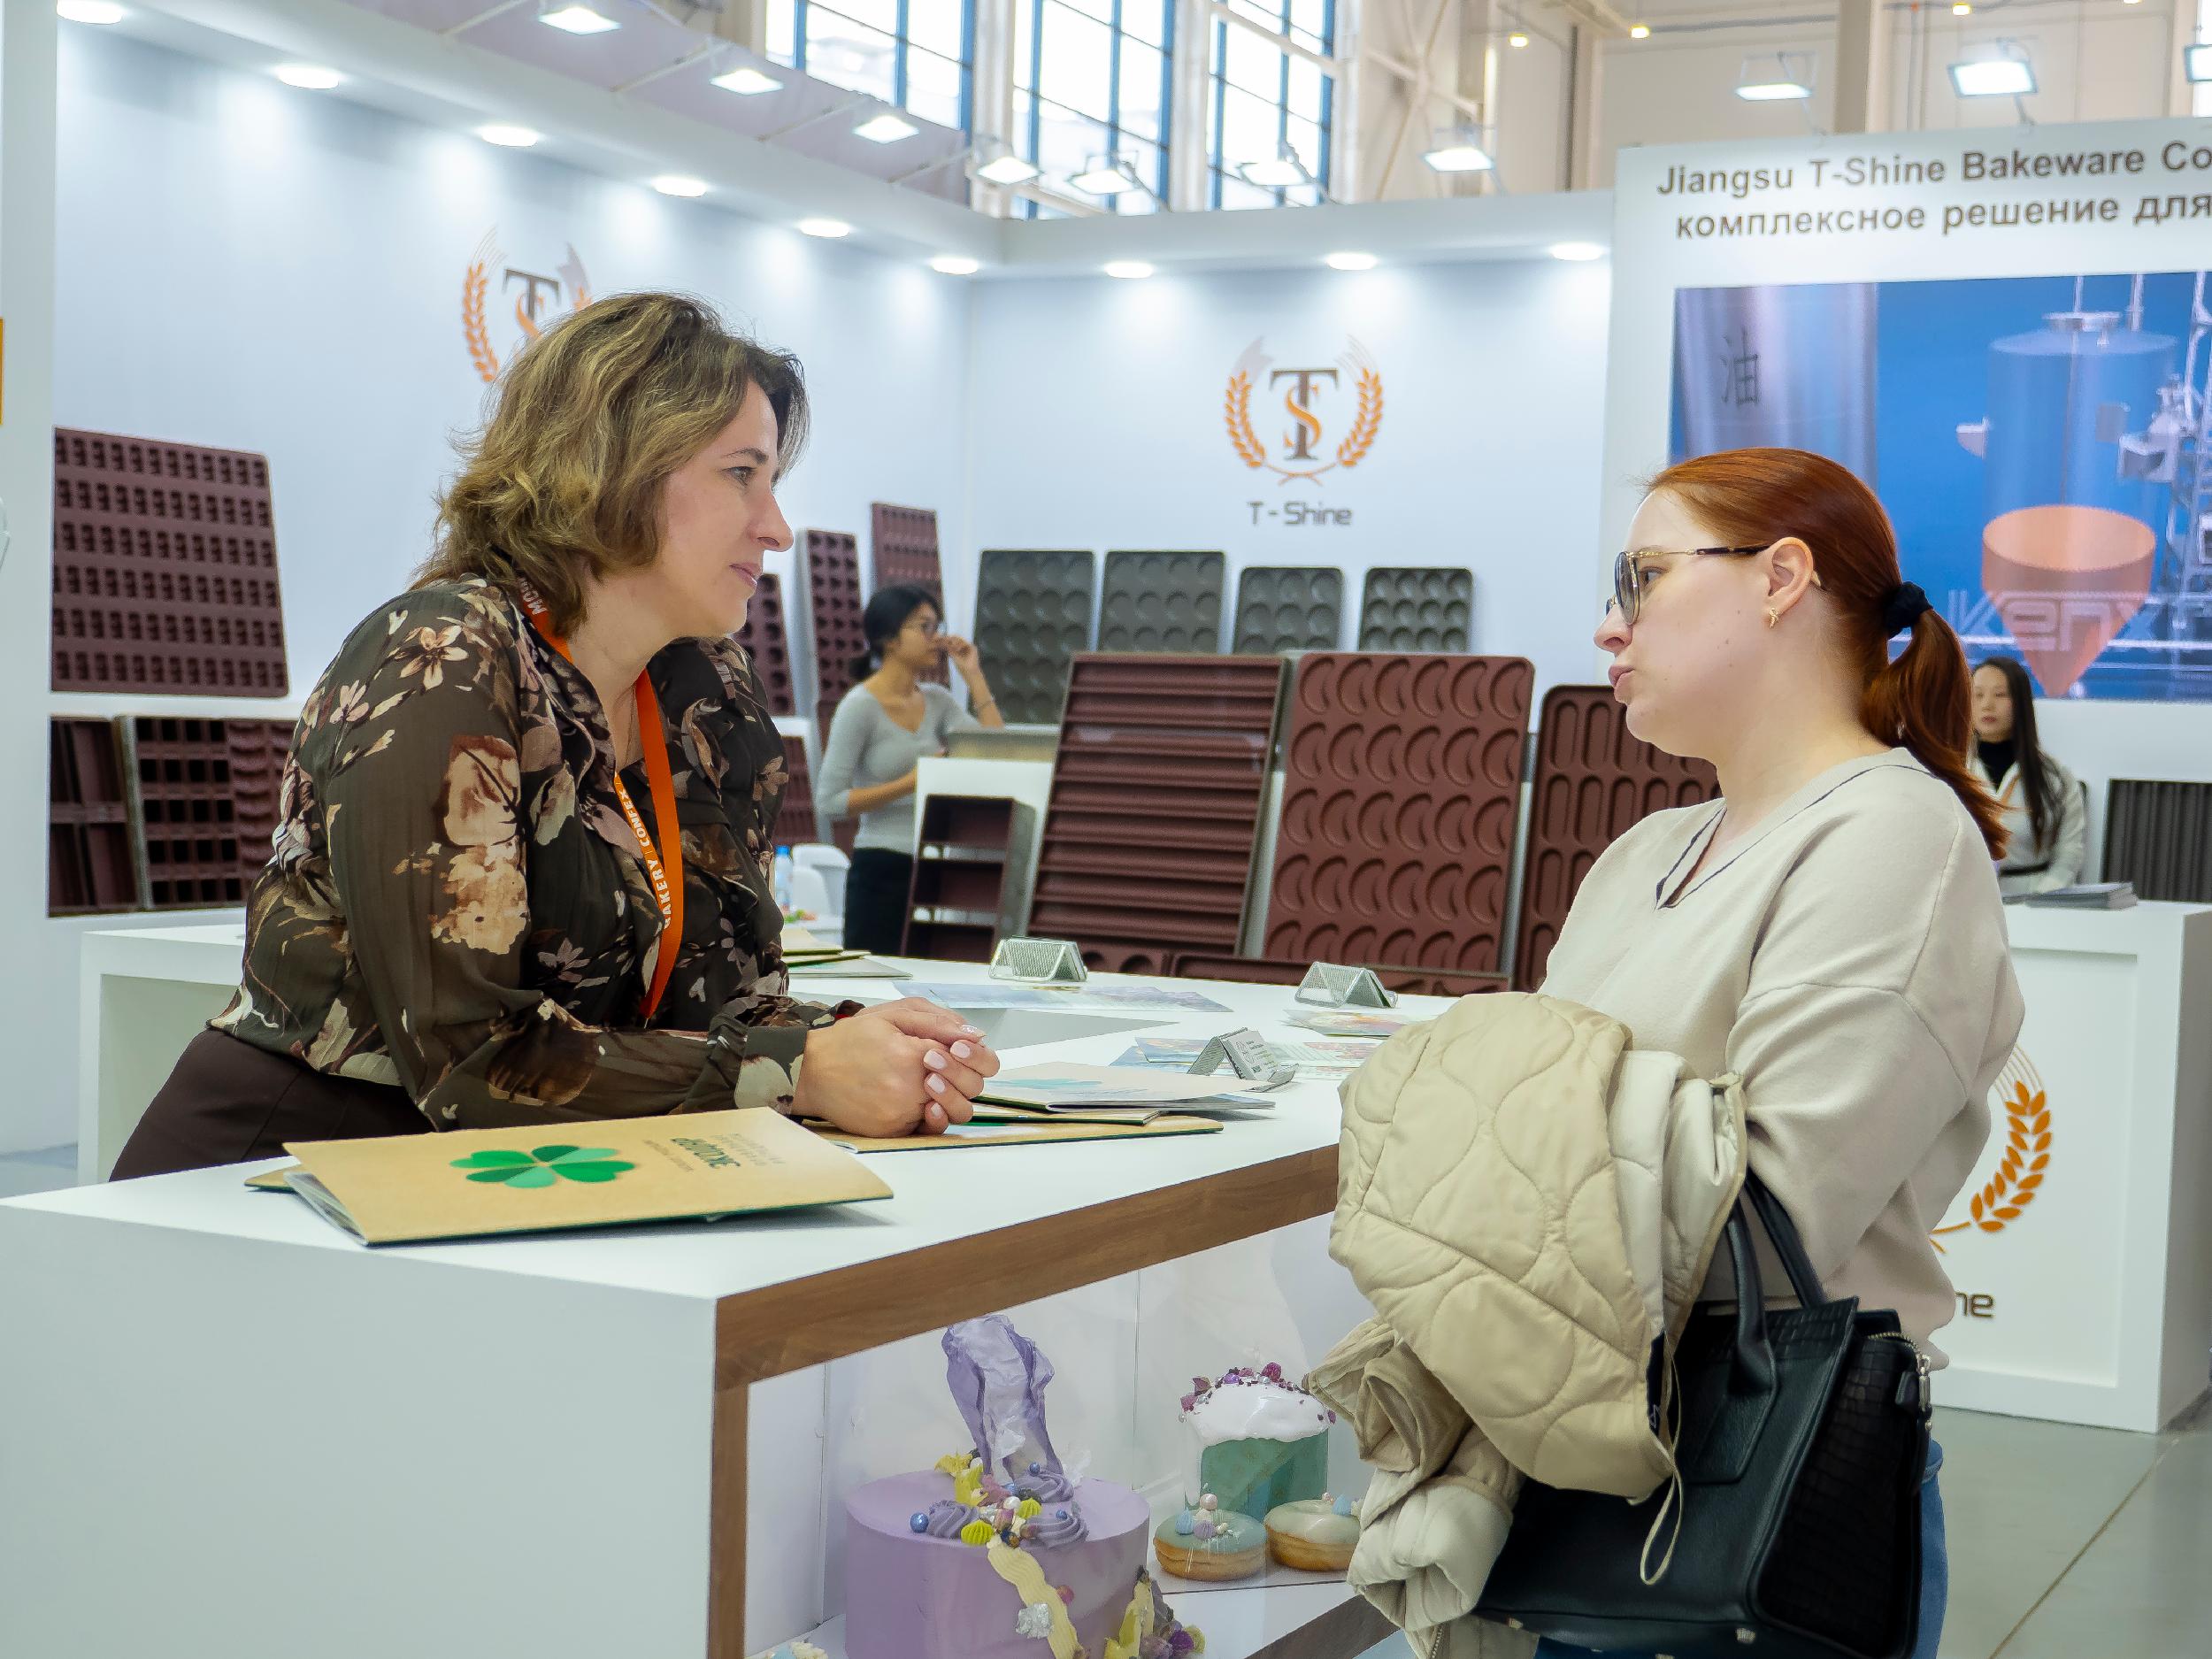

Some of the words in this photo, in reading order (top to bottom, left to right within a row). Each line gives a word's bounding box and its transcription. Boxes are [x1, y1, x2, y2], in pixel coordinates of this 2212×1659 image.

[1656, 165, 1793, 199] Jiangsu
[1809, 154, 1945, 188] T-Shine
[1962, 143, 2146, 180] Bakeware
[1676, 204, 1925, 240] комплексное
[1942, 195, 2120, 235] решение
[2134, 190, 2212, 224] для
[1720, 325, 1759, 406] 油
[619, 787, 650, 848] CONFEX
